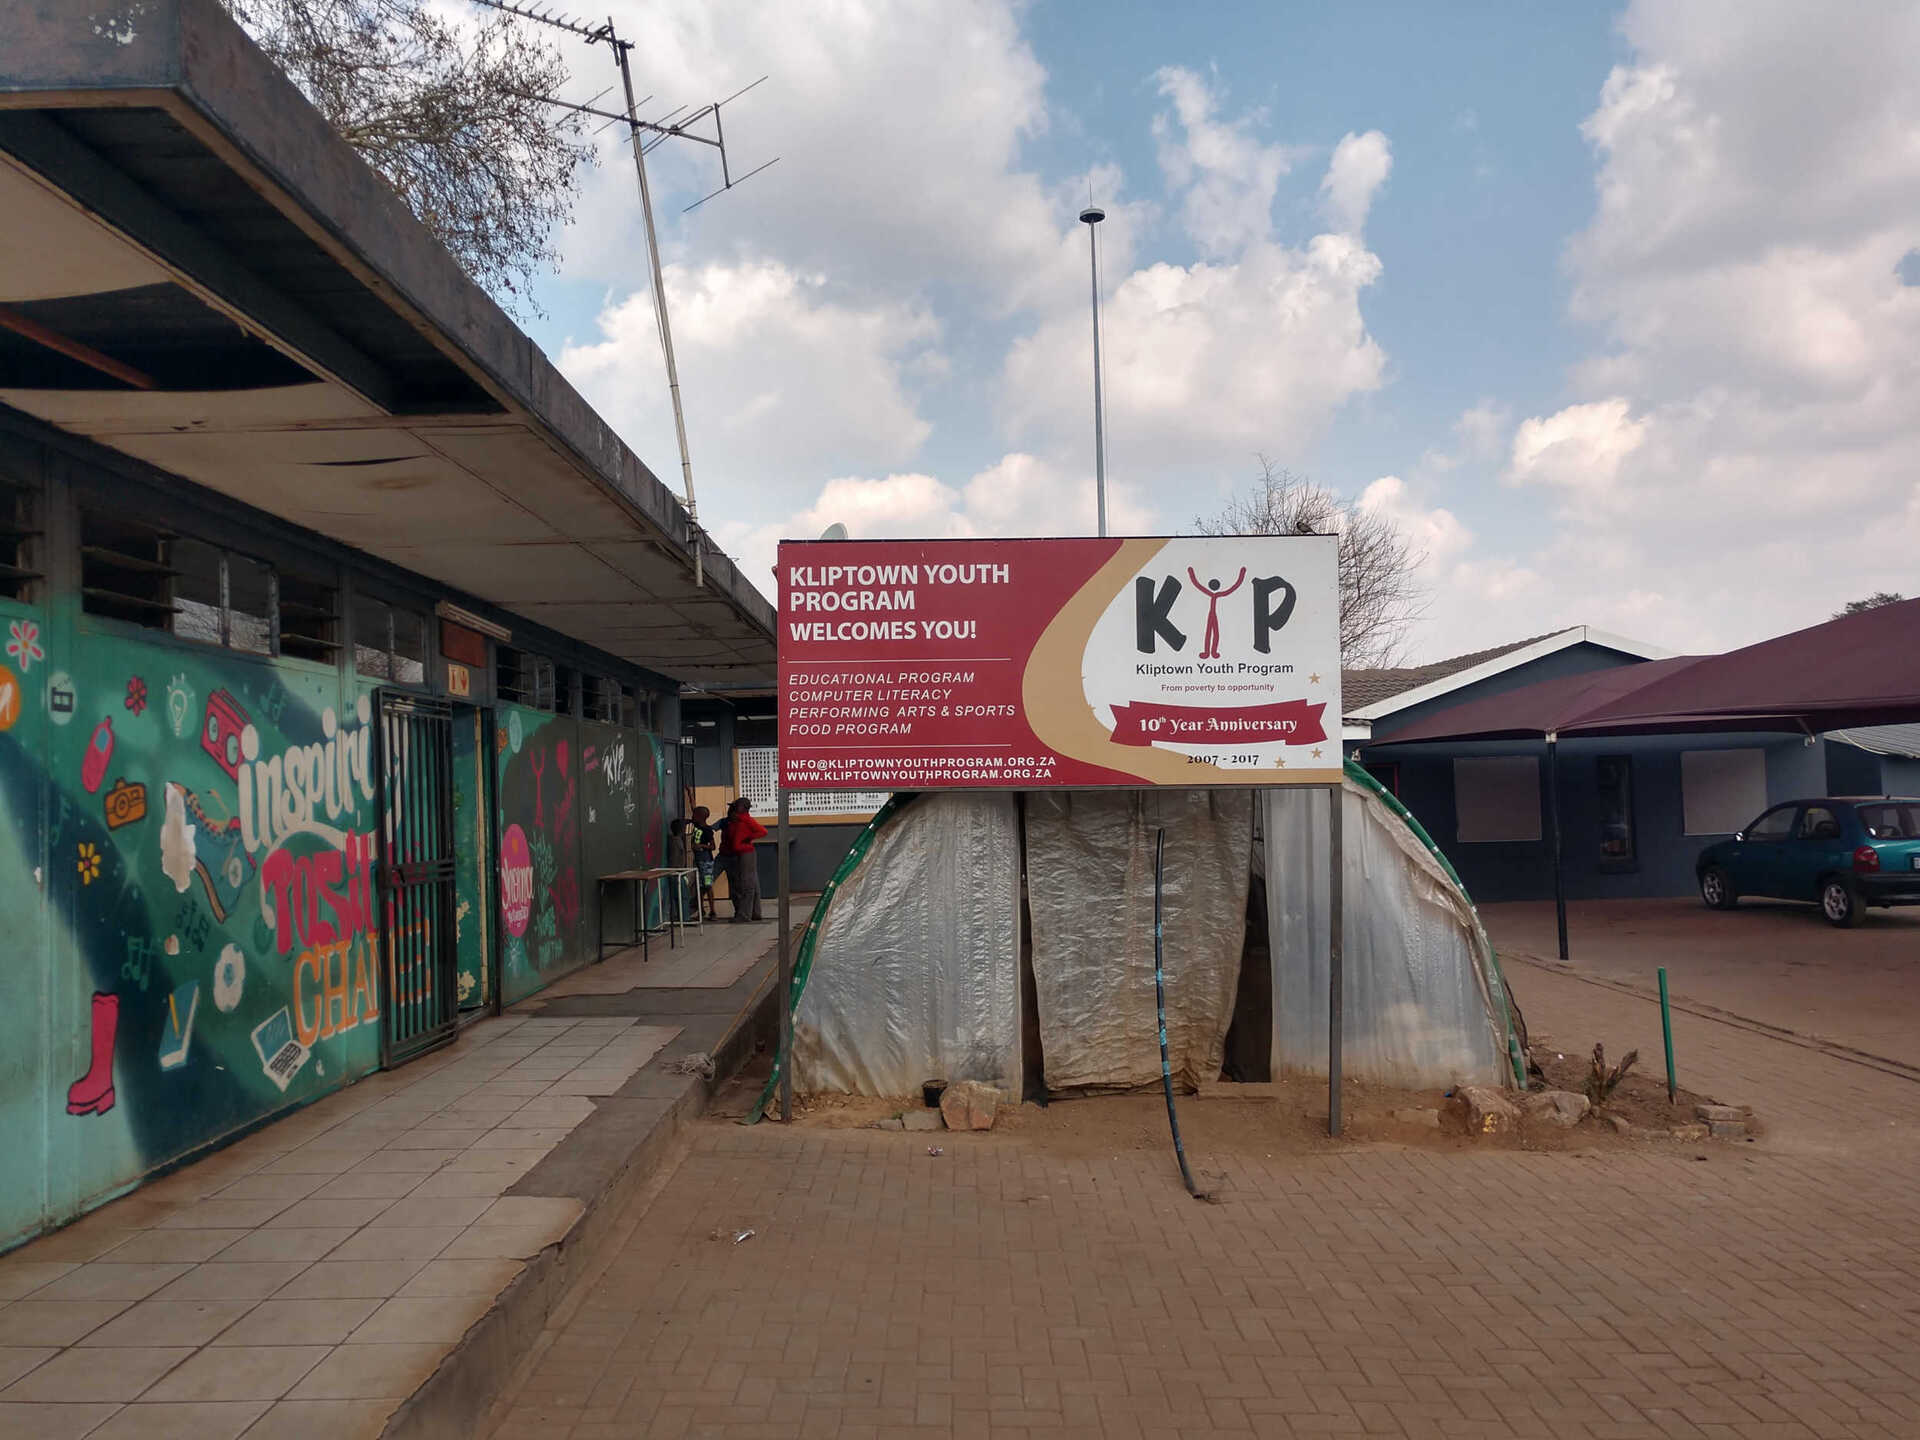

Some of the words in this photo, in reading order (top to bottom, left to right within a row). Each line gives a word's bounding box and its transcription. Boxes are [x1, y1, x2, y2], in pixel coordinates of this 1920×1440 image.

[790, 565, 918, 586] KLIPTOWN
[923, 564, 1009, 584] YOUTH
[790, 591, 915, 611] PROGRAM
[790, 621, 917, 640] WELCOMES
[921, 620, 977, 639] YOU!
[1136, 663, 1193, 676] Kliptown
[1196, 663, 1234, 674] Youth
[1238, 663, 1294, 676] Program
[789, 672, 894, 685] EDUCATIONAL
[898, 672, 975, 684] PROGRAM
[1184, 684, 1215, 692] poverty
[1217, 684, 1226, 692] to
[1227, 683, 1275, 692] opportunity
[789, 690, 873, 701] COMPUTER
[877, 689, 952, 700] LITERACY
[789, 706, 890, 718] PERFORMING
[897, 706, 936, 717] ARTS
[941, 705, 949, 716] &
[954, 705, 1016, 716] SPORTS
[789, 724, 831, 735] FOOD
[835, 723, 912, 734] PROGRAM
[1169, 718, 1204, 734] Year
[1206, 717, 1297, 732] Anniversary
[787, 757, 1056, 770] INFO@KLIPTOWNYOUTHPROGRAM.ORG.ZA
[1187, 755, 1219, 765] 2007
[1231, 754, 1260, 765] 2017
[787, 769, 1052, 781] WWW.KLIPTOWNYOUTHPROGRAM.ORG.ZA
